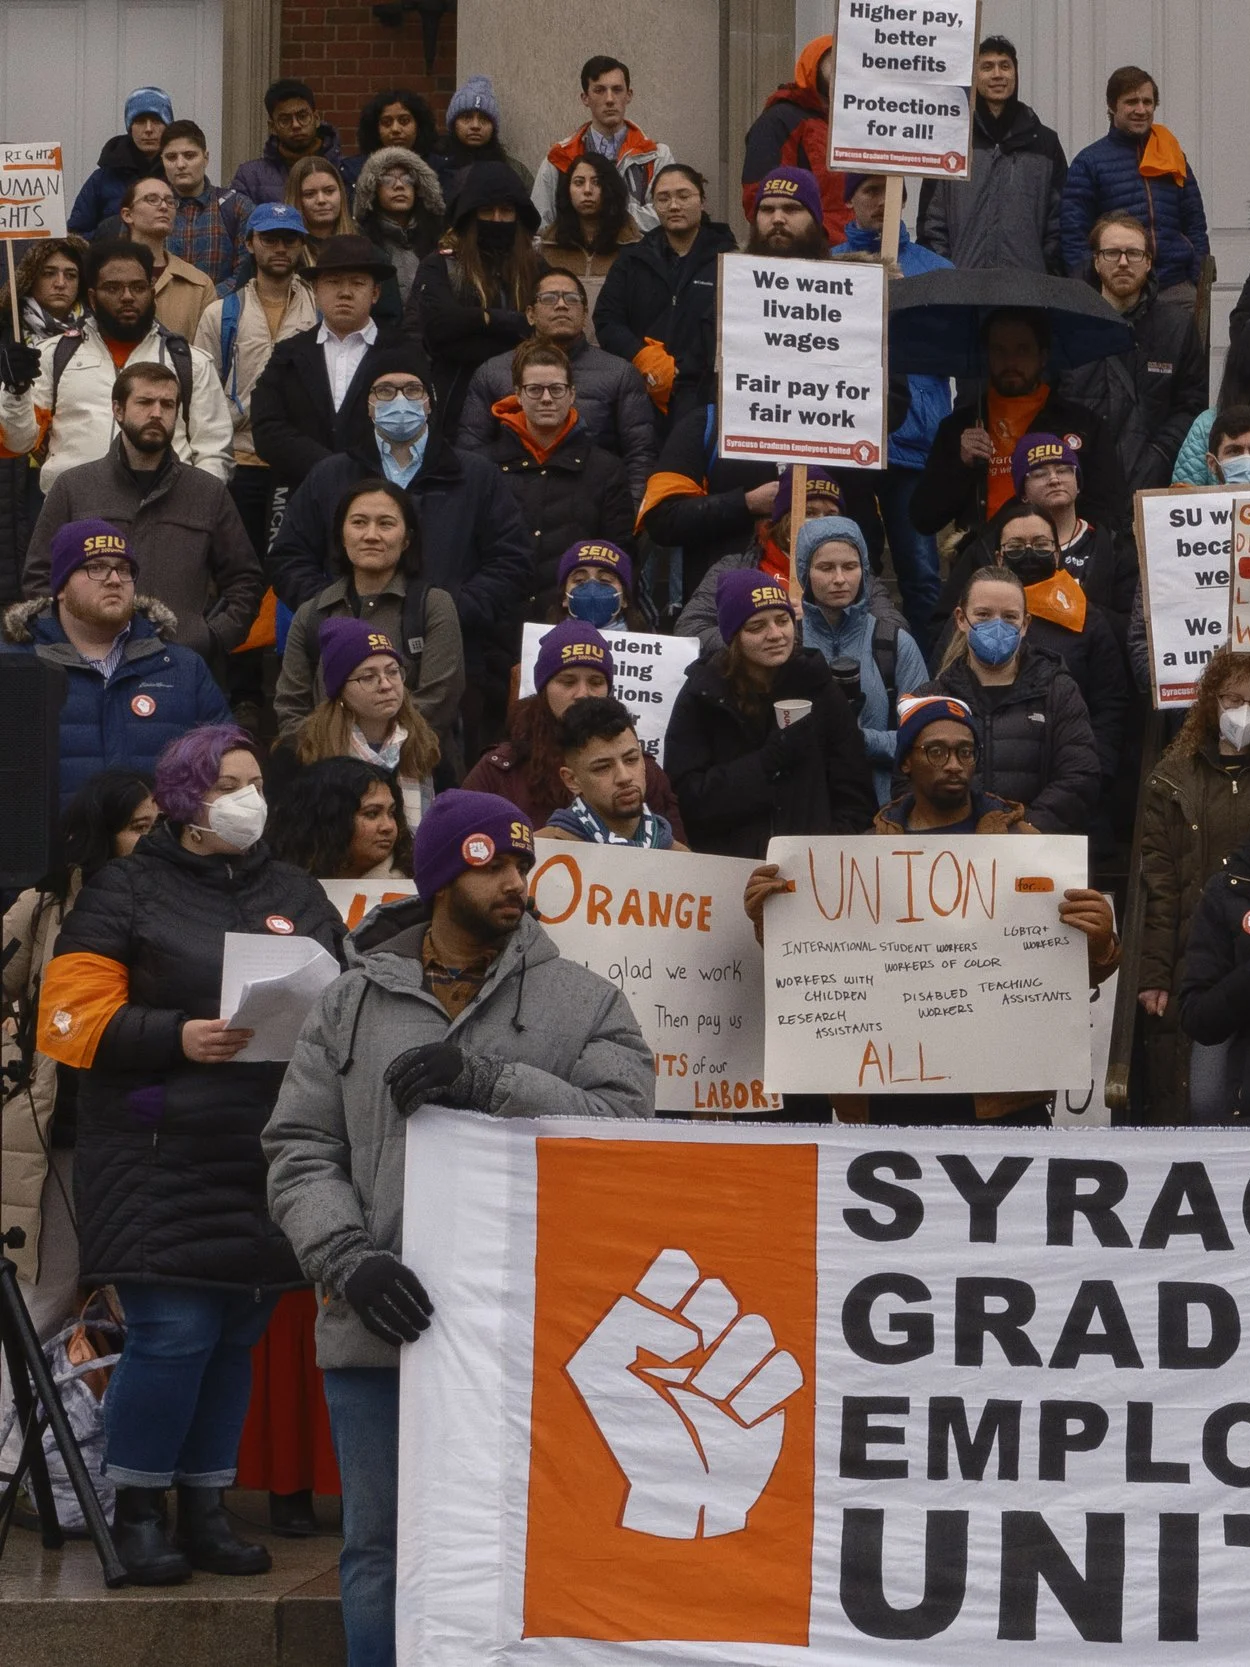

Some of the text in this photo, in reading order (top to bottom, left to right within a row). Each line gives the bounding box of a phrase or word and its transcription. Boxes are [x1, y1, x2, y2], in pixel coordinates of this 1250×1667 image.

[850, 3, 962, 27] Higher pay,
[875, 29, 936, 46] better
[862, 53, 946, 72] benefits
[844, 94, 960, 116] Protections
[867, 120, 933, 139] for all!
[0, 175, 59, 196] UMAN
[764, 179, 798, 192] SEIU
[753, 270, 853, 295] We want
[764, 300, 841, 322] livable
[765, 332, 839, 352] wages
[736, 374, 870, 401] Fair pay for
[749, 403, 855, 428] fair work
[1027, 444, 1063, 461] SEIU
[84, 536, 126, 551] SEIU
[578, 545, 620, 563] SEIU
[752, 587, 786, 602] SEIU
[529, 854, 712, 932] ORANGE
[808, 847, 997, 925] UNION
[1004, 926, 1049, 937] LGBTQ+
[782, 941, 978, 957] INTERNATIONAL STUDENT WORKERS
[1023, 937, 1070, 950] WORKERS
[608, 956, 742, 990] glad we work
[885, 958, 1002, 973] WORKERS OF COLOR
[776, 974, 874, 988] WORKERS WITH
[978, 977, 1043, 993] TEACHING
[805, 990, 867, 1002] CHILDREN
[902, 989, 968, 1003] DISABLED
[1002, 992, 1072, 1005] ASSISTANTS
[655, 1004, 743, 1035] Then pay us
[778, 1010, 847, 1025] RESEARCH
[918, 1004, 974, 1018] WORKERS
[816, 1022, 882, 1039] ASSISTANTS
[692, 1060, 727, 1075] of our
[859, 1039, 950, 1087] ALL
